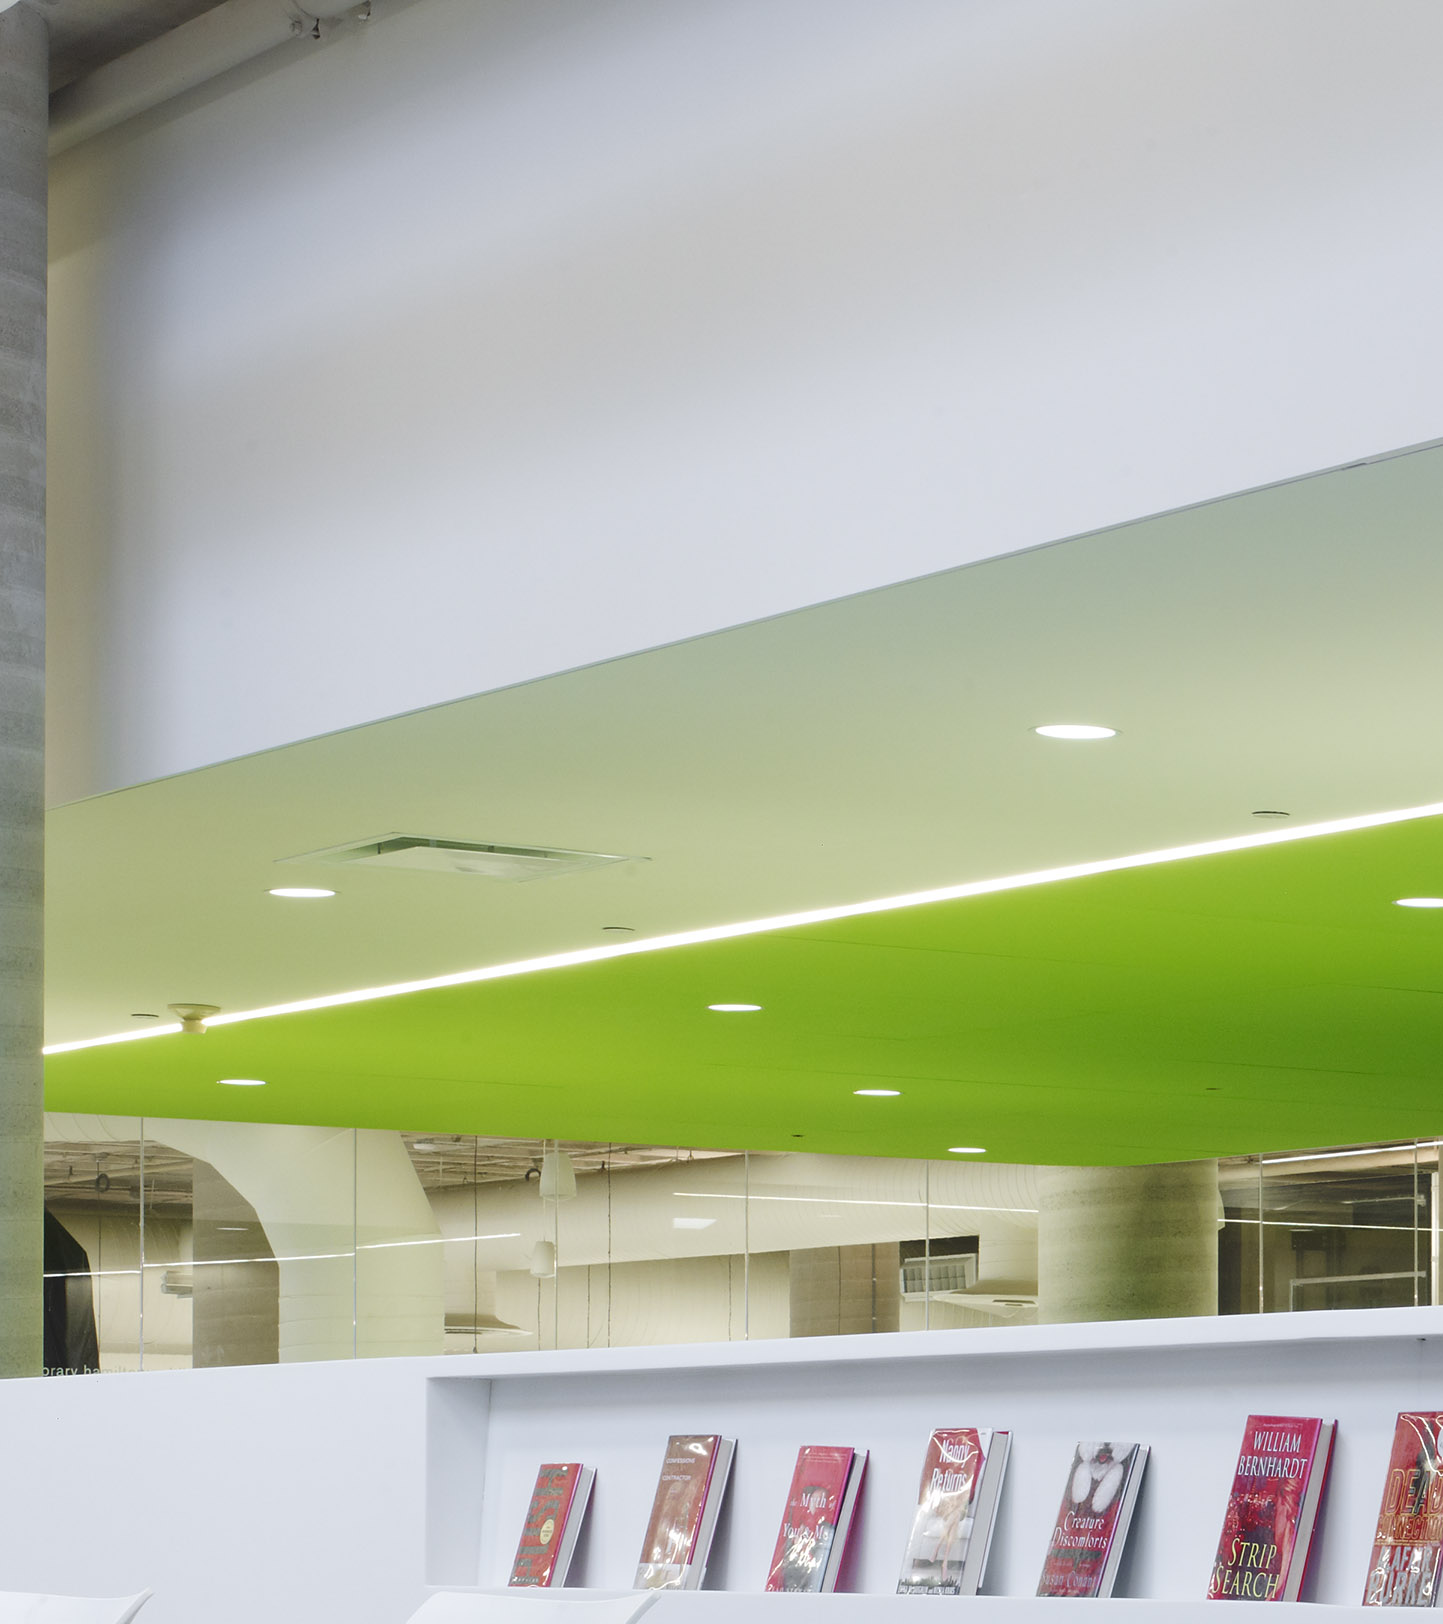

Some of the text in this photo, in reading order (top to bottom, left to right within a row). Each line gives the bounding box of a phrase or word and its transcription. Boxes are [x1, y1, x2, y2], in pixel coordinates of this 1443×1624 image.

[938, 1439, 970, 1468] Nanny
[1253, 1431, 1302, 1453] WILLIAM
[1238, 1455, 1308, 1479] BERNHARDT
[930, 1468, 968, 1492] Returns
[1064, 1511, 1105, 1532] Creature
[1052, 1526, 1108, 1549] Discomforts
[1228, 1537, 1278, 1569] STRIP
[1212, 1565, 1280, 1599] SEARCH
[1366, 1571, 1432, 1607] BURKE
